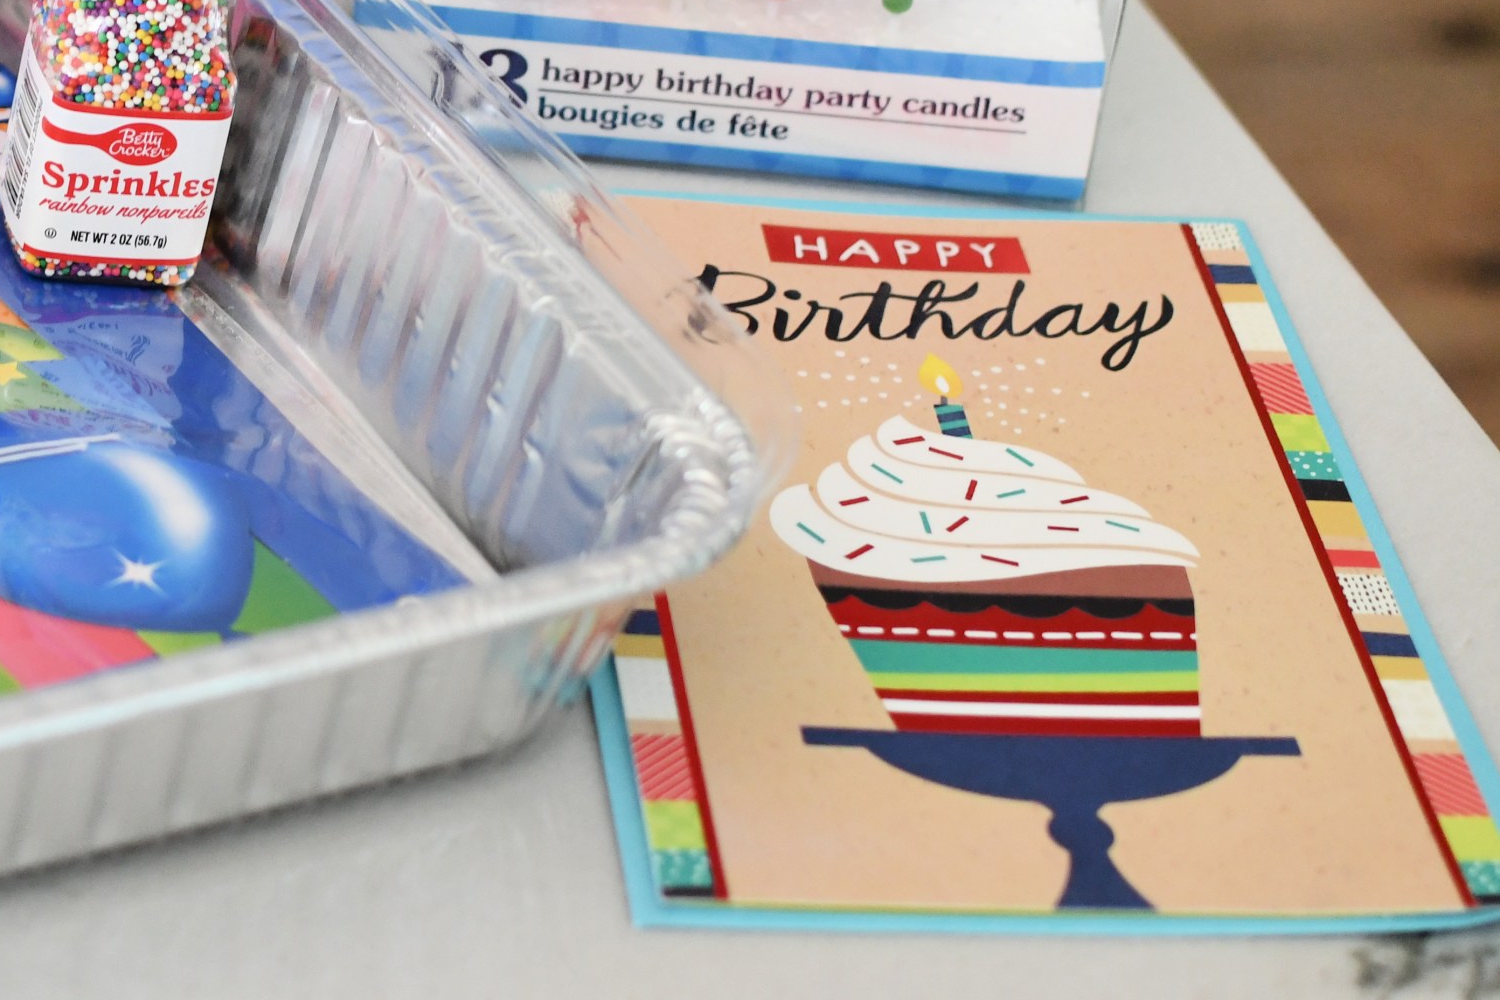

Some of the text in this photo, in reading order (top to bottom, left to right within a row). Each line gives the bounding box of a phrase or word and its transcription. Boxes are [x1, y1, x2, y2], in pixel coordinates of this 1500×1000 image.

[541, 58, 1026, 124] happy birthday party candles
[537, 96, 789, 140] bougies de fête
[108, 139, 170, 158] Crocker
[119, 127, 165, 150] Betty
[41, 160, 215, 199] Sprinkles
[38, 196, 209, 225] rainbow nonpareils
[70, 230, 168, 249] NET WT 2 OZ (56.7g)
[792, 234, 997, 269] HAPPY
[685, 263, 1175, 372] Birthday
